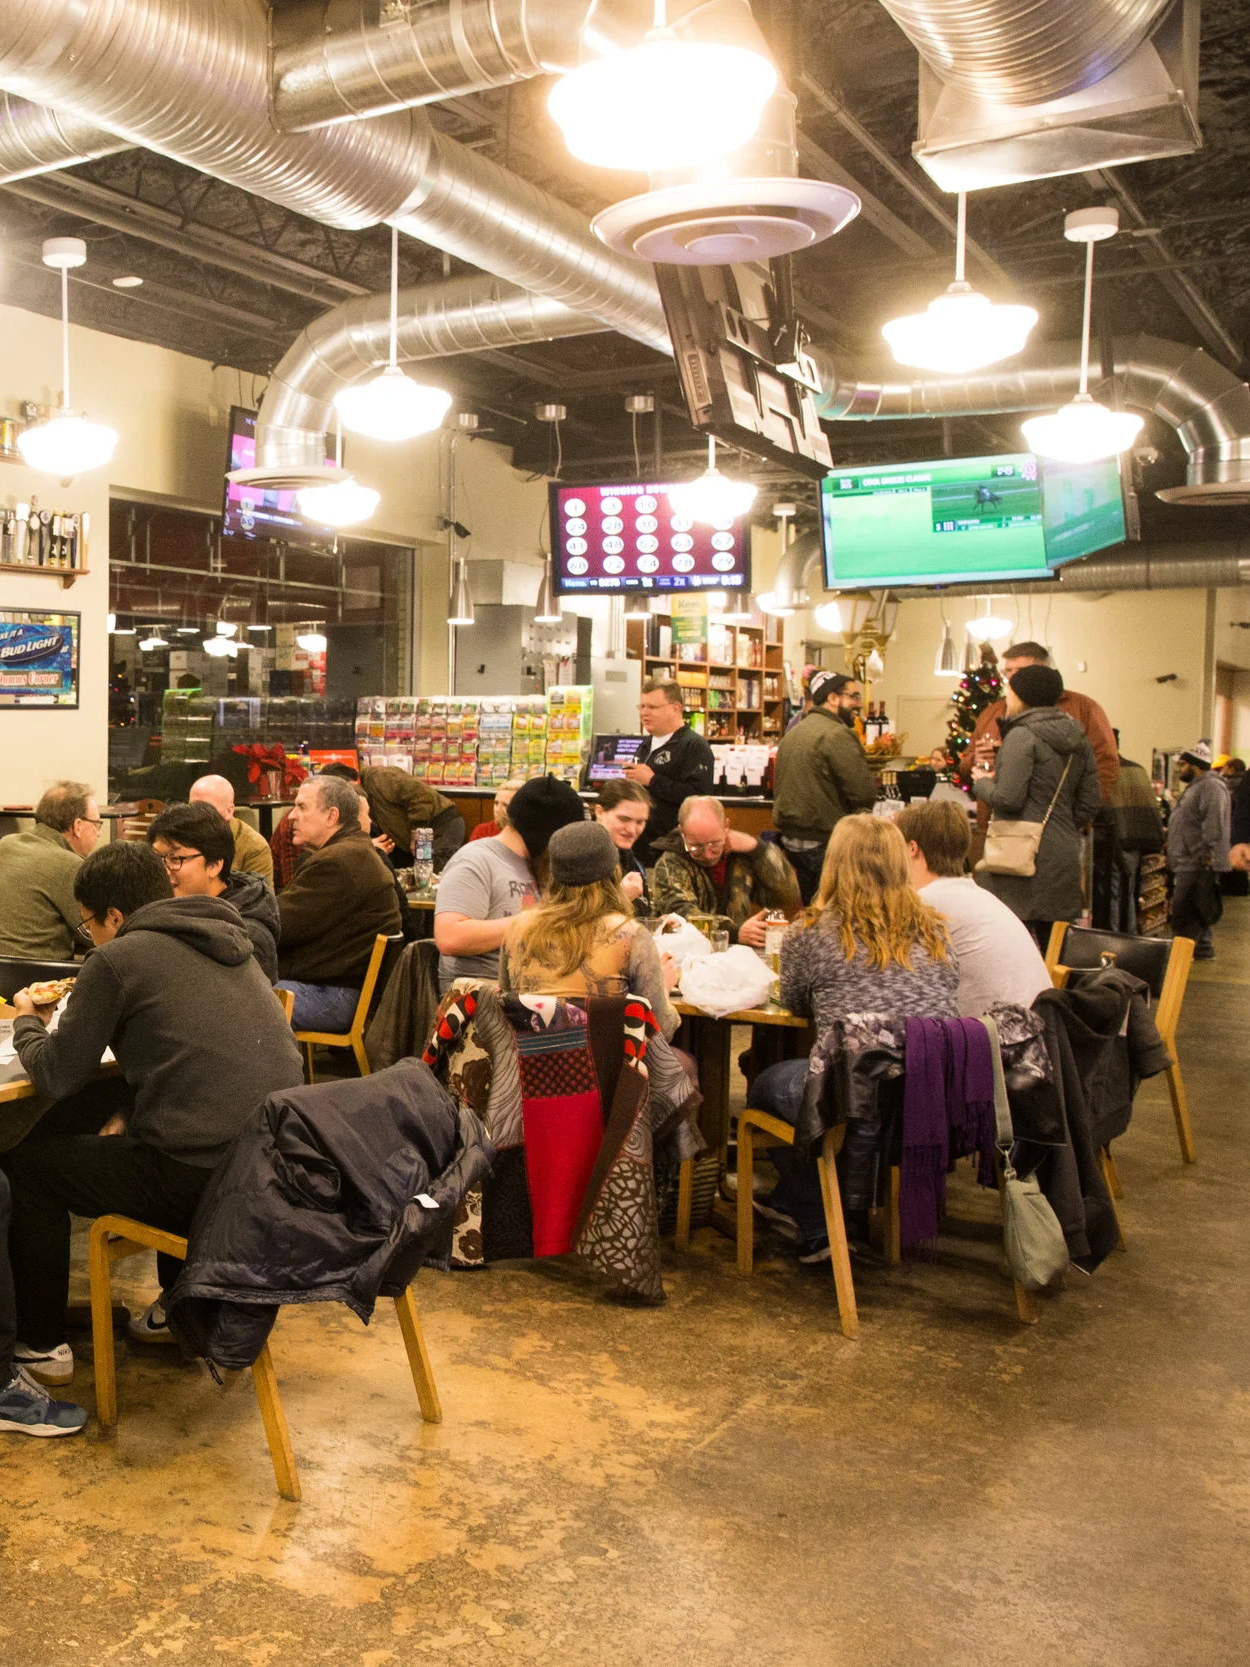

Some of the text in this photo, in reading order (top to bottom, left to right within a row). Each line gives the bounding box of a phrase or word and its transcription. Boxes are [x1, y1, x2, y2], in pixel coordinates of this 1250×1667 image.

[10, 630, 17, 638] IT
[17, 628, 23, 636] A
[0, 636, 60, 659] BUD LIGHT
